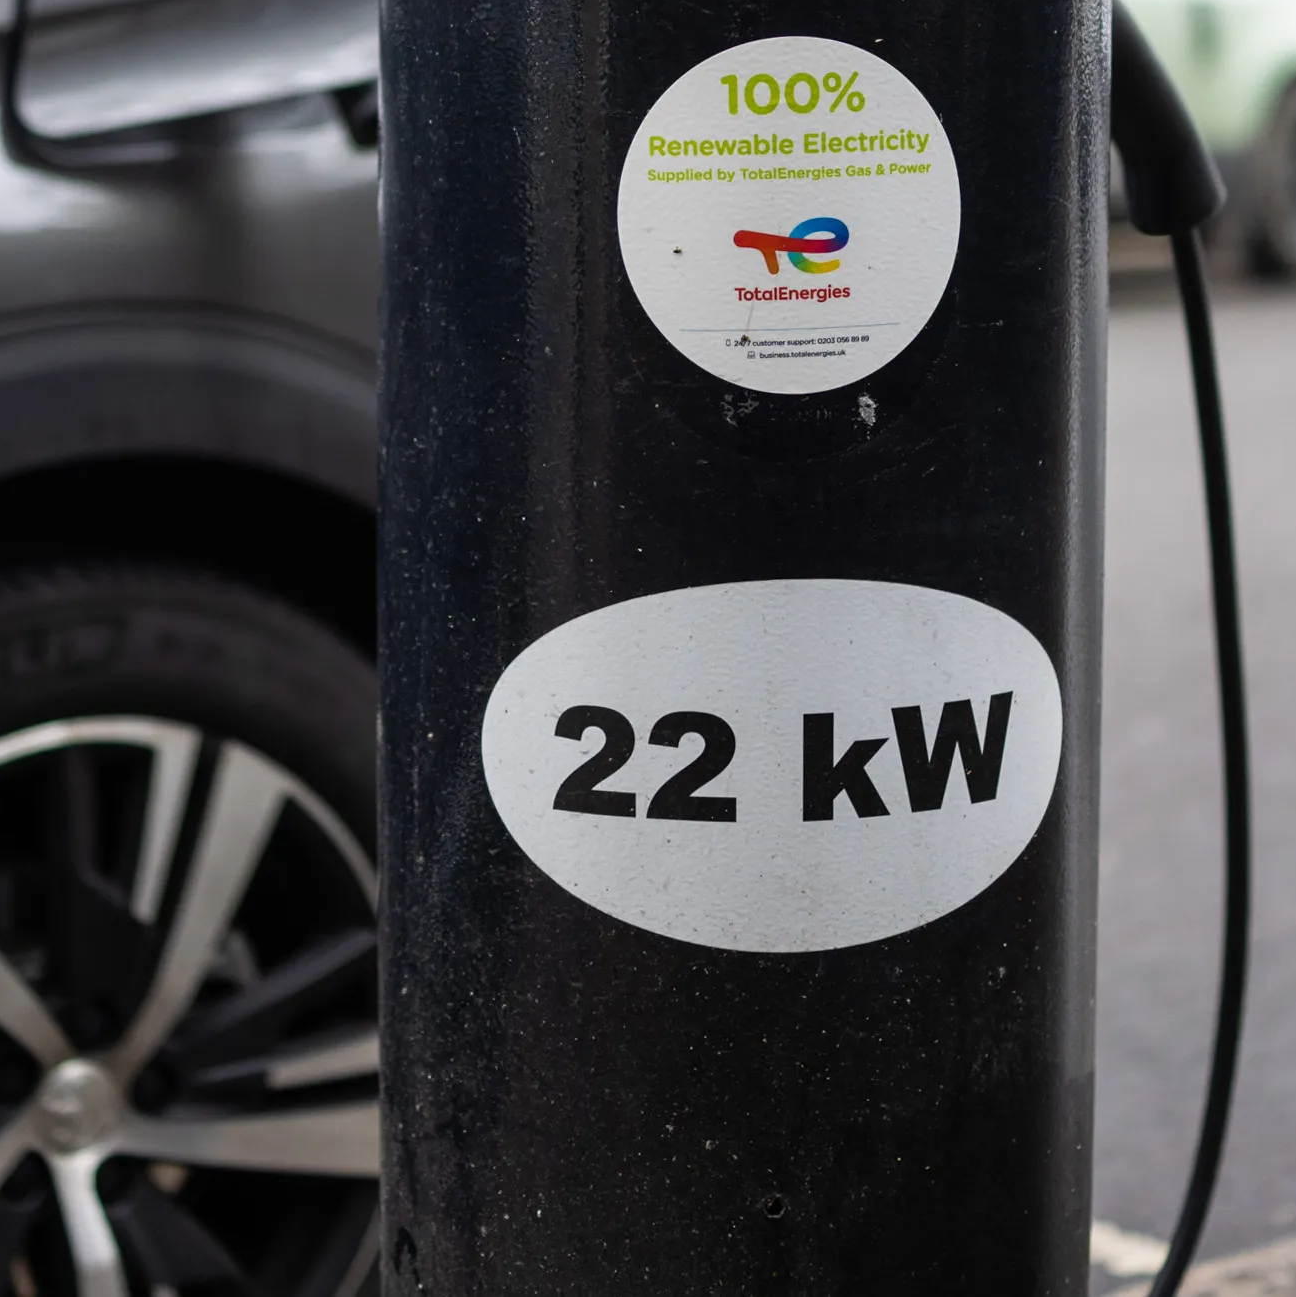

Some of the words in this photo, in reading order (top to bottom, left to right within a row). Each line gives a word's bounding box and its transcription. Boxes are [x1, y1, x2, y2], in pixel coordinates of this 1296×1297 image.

[720, 71, 865, 115] 100%
[649, 133, 794, 157] Renewable
[803, 129, 930, 154] Electricity
[648, 168, 713, 183] Supplied
[717, 168, 736, 183] by
[741, 165, 841, 181] TotalEnergies
[846, 164, 872, 177] Gas
[876, 164, 885, 176] &
[889, 162, 931, 175] Power
[734, 284, 851, 302] TotalEnergies
[753, 339, 786, 347] customer
[786, 338, 816, 347] support:
[817, 336, 836, 345] 0203
[759, 349, 847, 359] business.totalenergies.uk
[552, 705, 737, 823] 22
[803, 691, 1014, 822] kW
